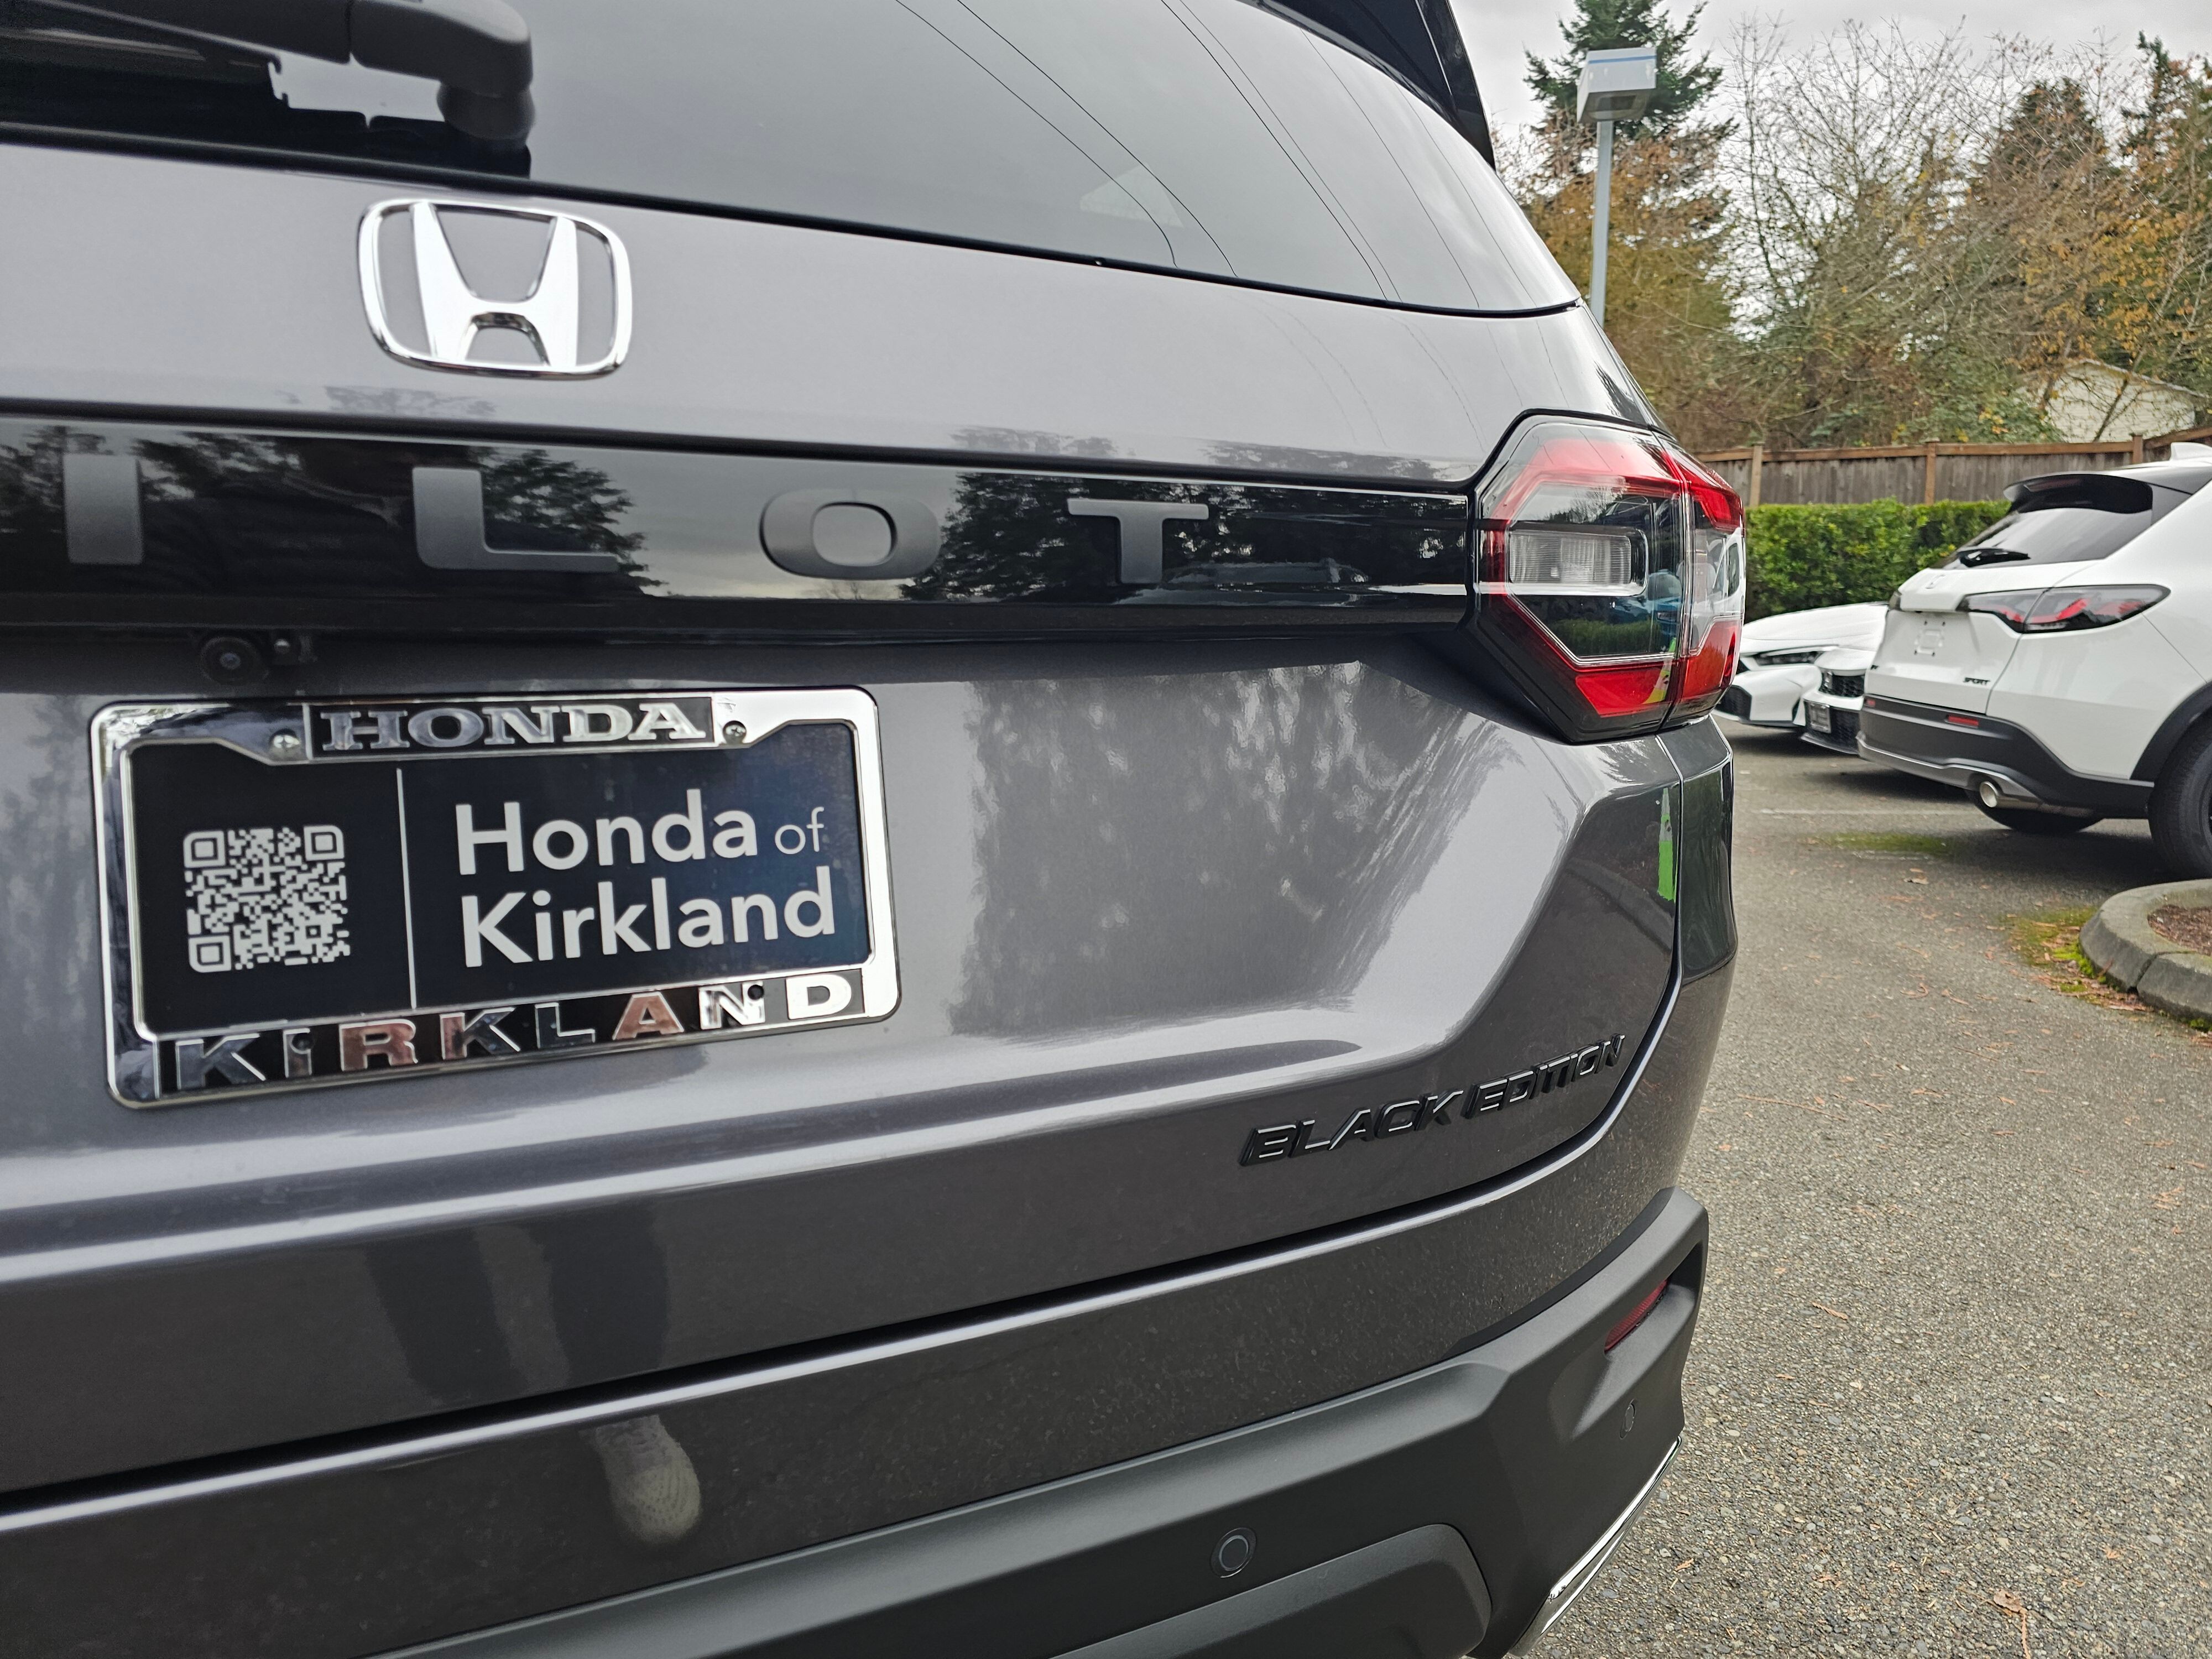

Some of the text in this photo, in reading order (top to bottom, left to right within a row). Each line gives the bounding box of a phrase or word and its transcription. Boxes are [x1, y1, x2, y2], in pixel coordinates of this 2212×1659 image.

[320, 702, 706, 752] HONDA
[455, 789, 825, 875] Honda of
[460, 867, 836, 968] Kirkland
[175, 973, 856, 1089] KIRKLAND
[1238, 1033, 1626, 1166] BLACK EDITION
